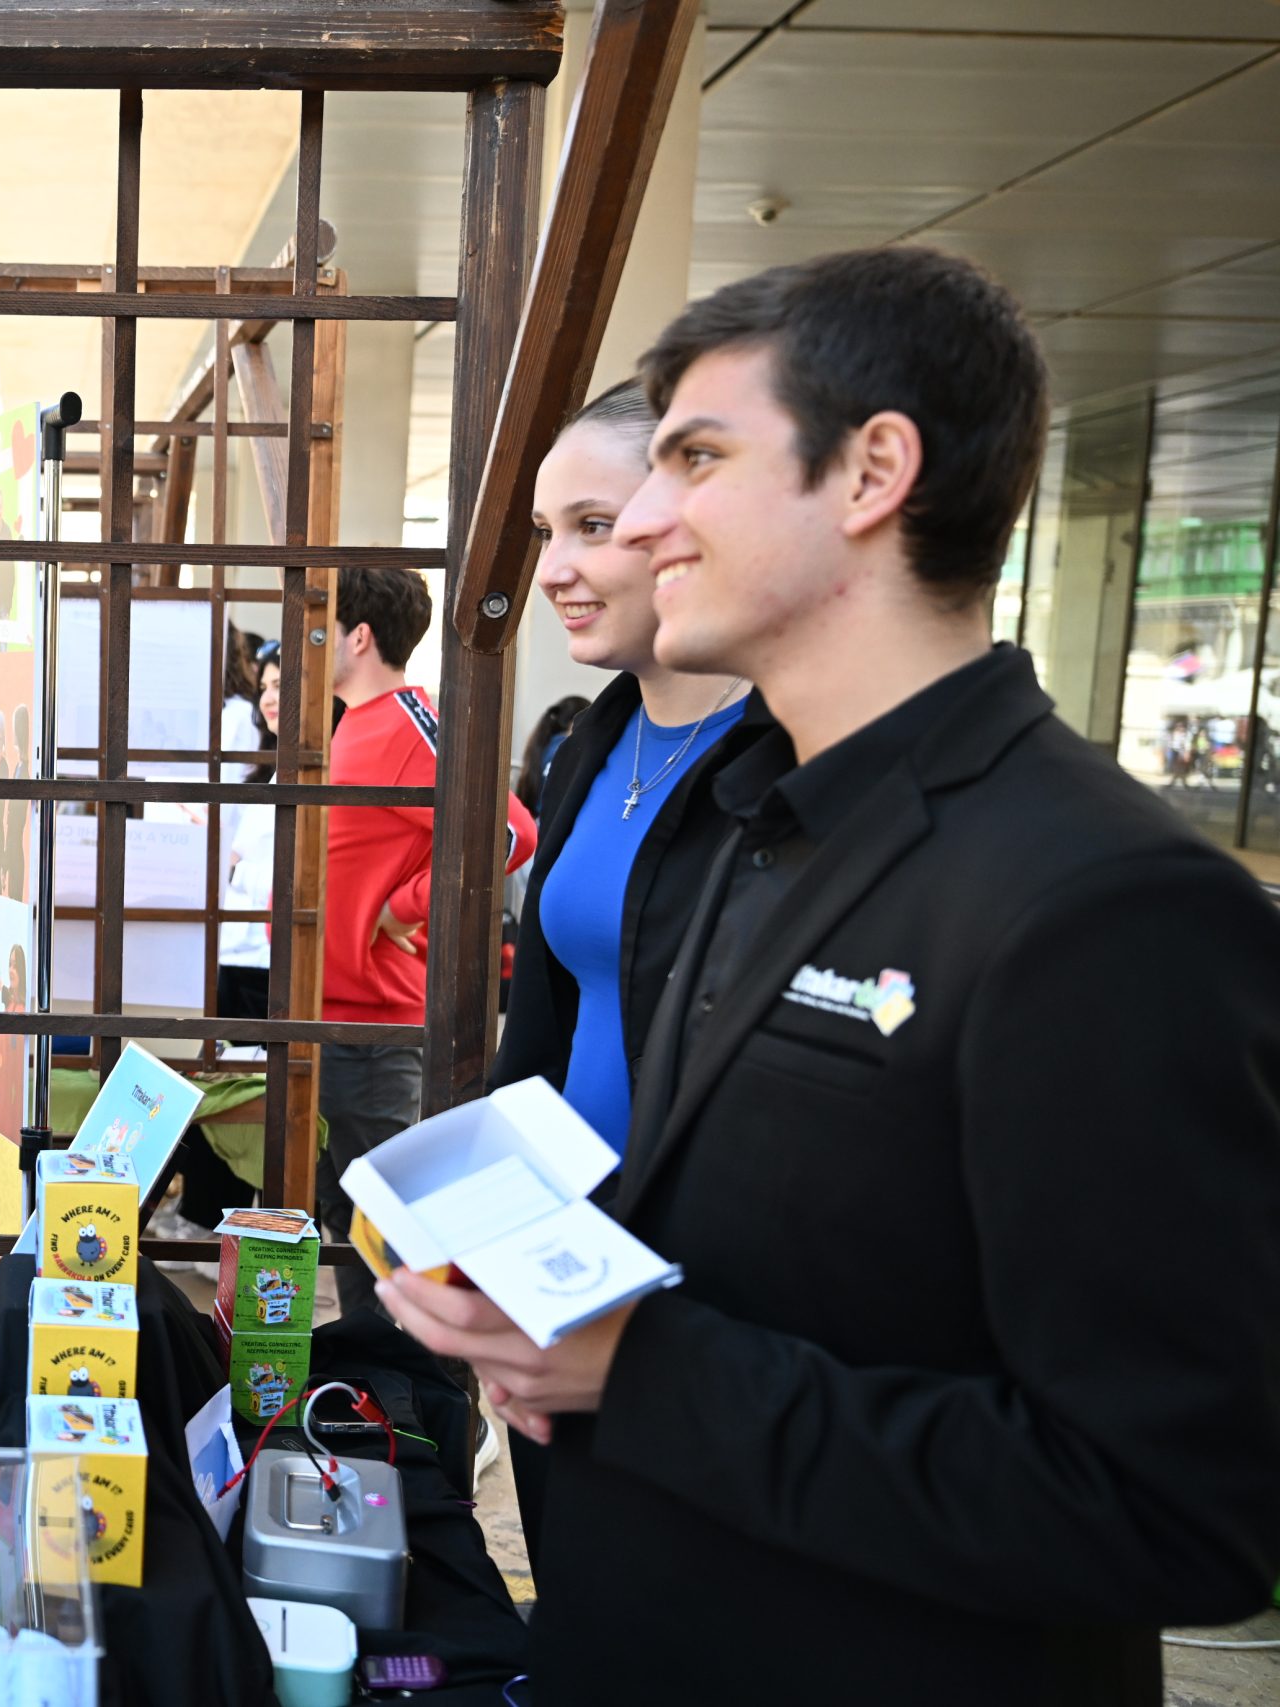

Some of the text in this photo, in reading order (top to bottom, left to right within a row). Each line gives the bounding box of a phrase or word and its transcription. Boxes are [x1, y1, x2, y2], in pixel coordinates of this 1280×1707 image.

[60, 1205, 121, 1224] WHERE AM I?
[50, 1233, 59, 1252] FIND
[93, 1274, 105, 1282] ON
[106, 1257, 126, 1279] EVERY
[122, 1235, 130, 1256] CARD
[50, 1346, 116, 1367] WHERE AM I?
[39, 1376, 48, 1395] FIN
[92, 1475, 111, 1488] AM
